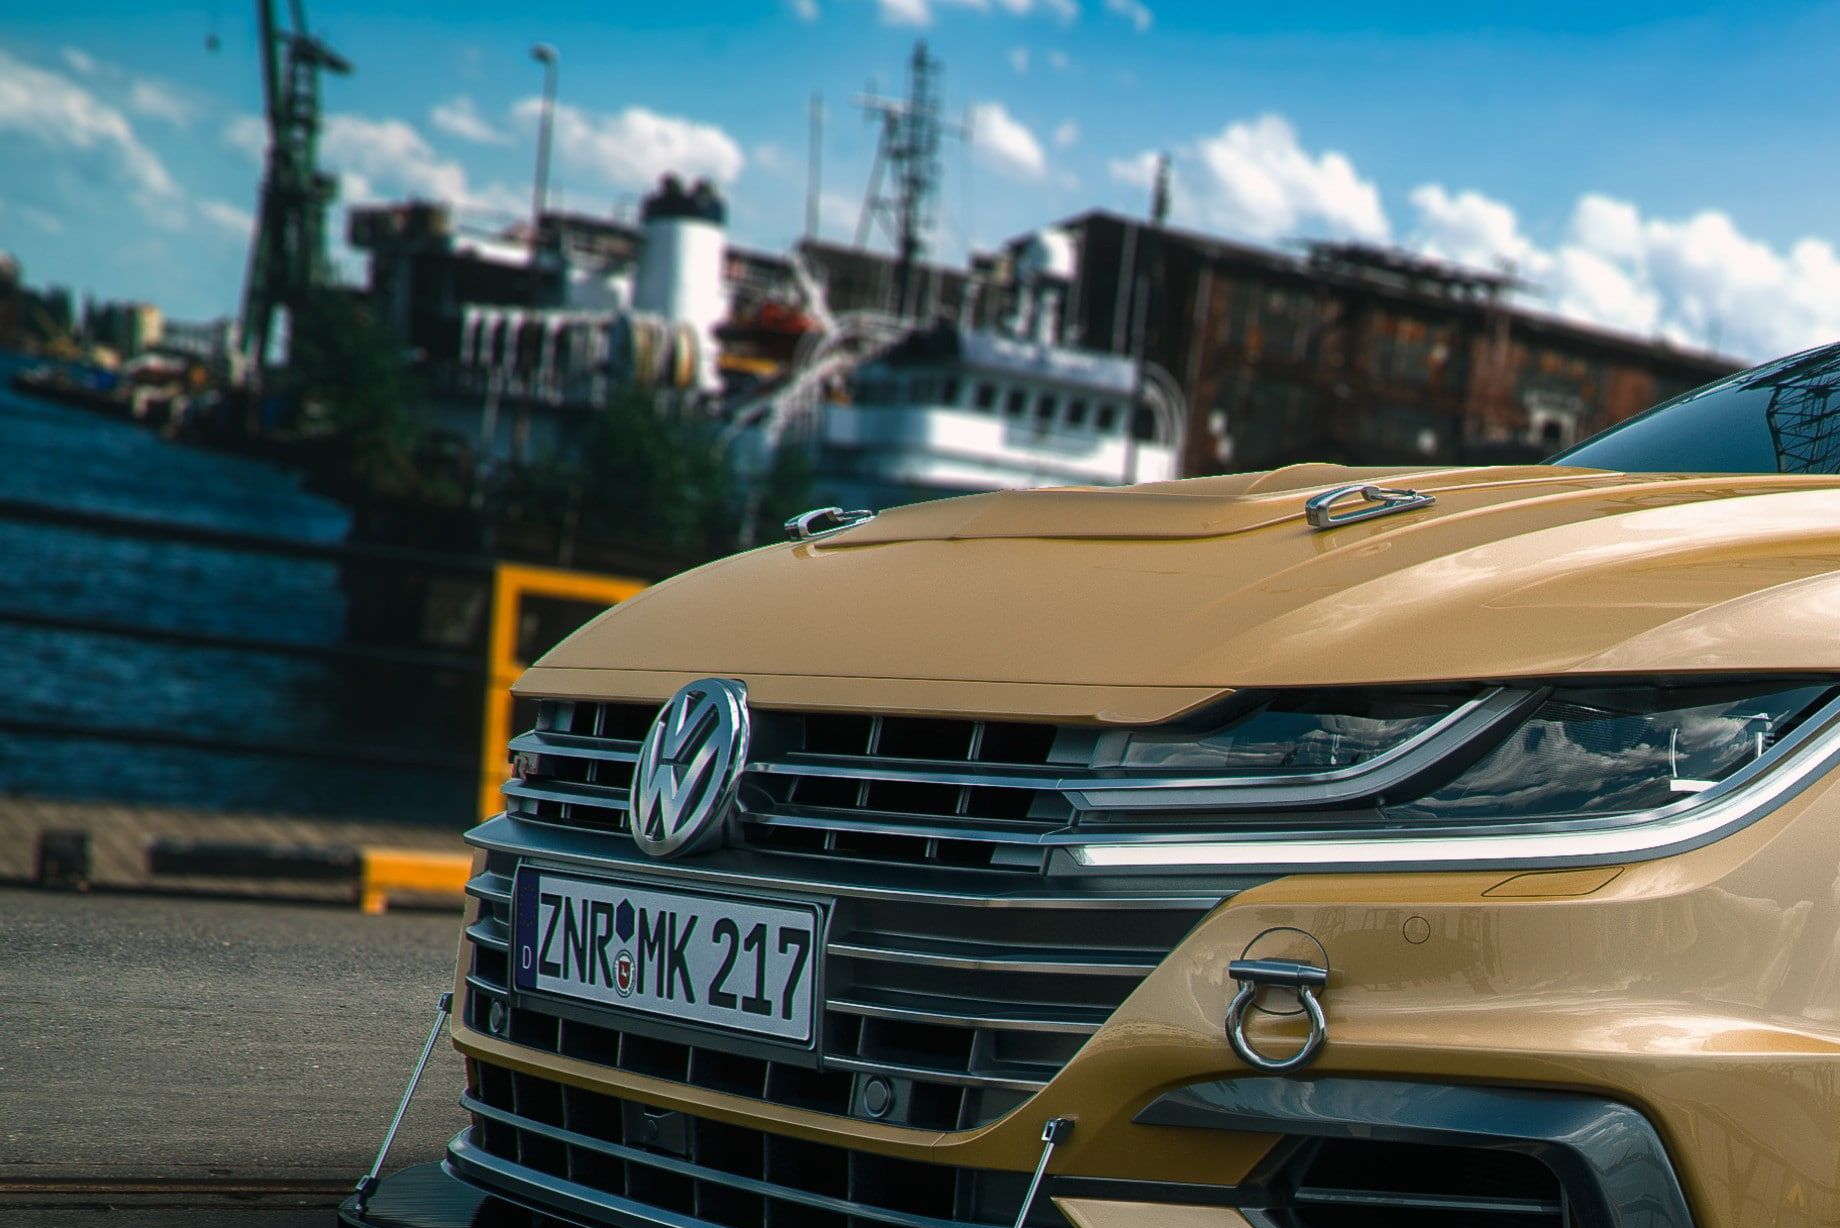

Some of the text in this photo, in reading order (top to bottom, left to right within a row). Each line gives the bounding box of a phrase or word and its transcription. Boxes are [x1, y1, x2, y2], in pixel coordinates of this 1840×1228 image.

[522, 945, 532, 970] D
[539, 893, 811, 1020] ZNR MK 217
